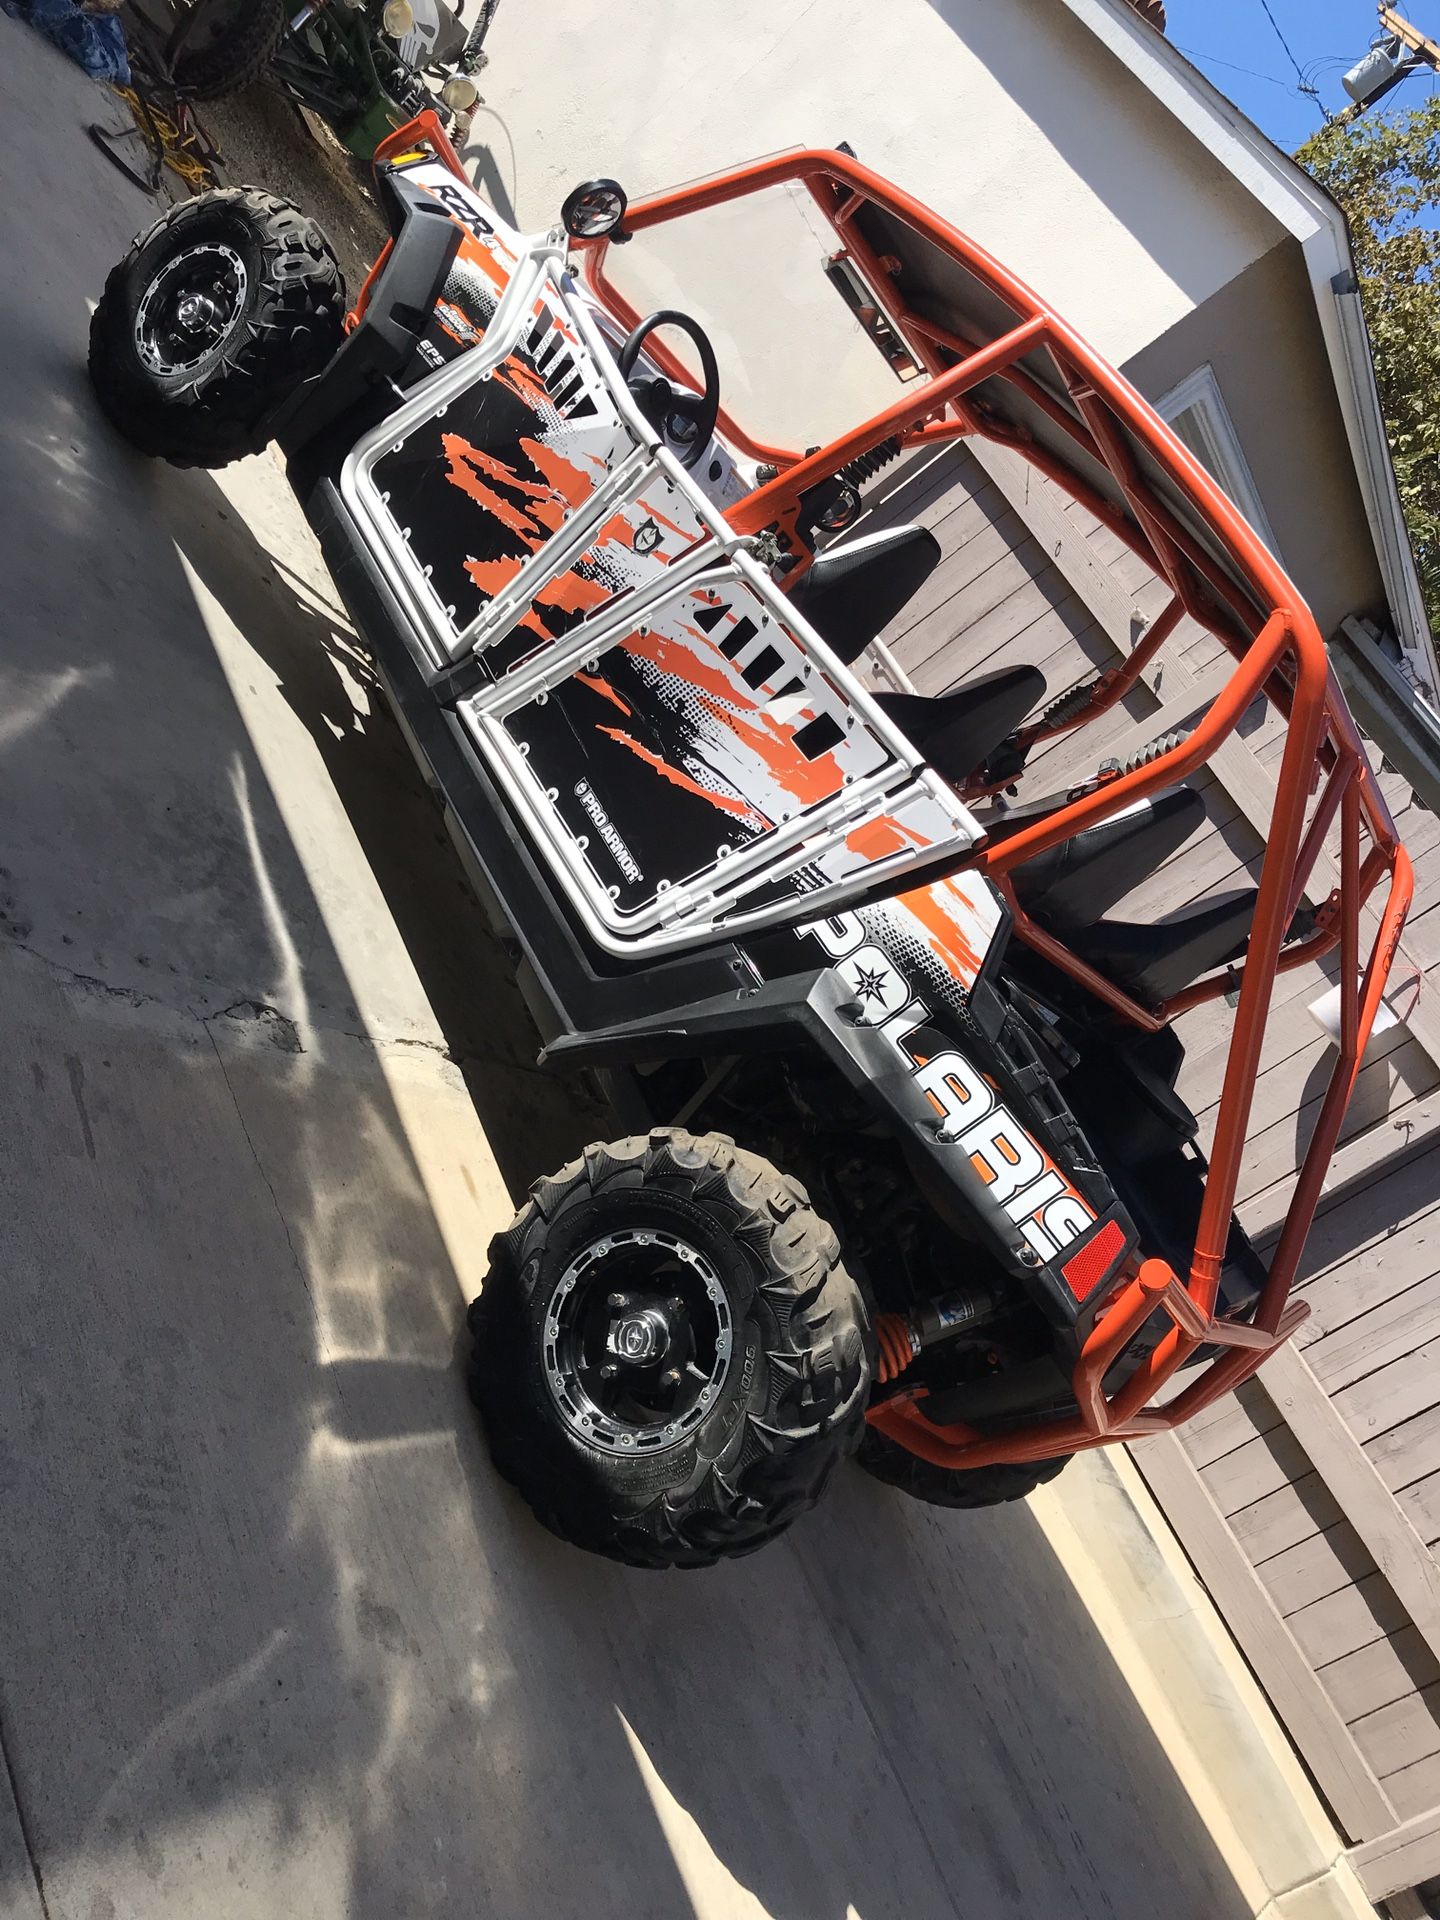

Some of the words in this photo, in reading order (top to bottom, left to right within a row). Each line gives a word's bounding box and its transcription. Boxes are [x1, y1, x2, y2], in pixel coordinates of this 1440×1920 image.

[427, 185, 494, 240] RZR
[420, 339, 447, 365] EPS
[581, 790, 607, 828] PRO
[600, 823, 641, 882] ARMOR
[793, 909, 1096, 1265] POLARIS
